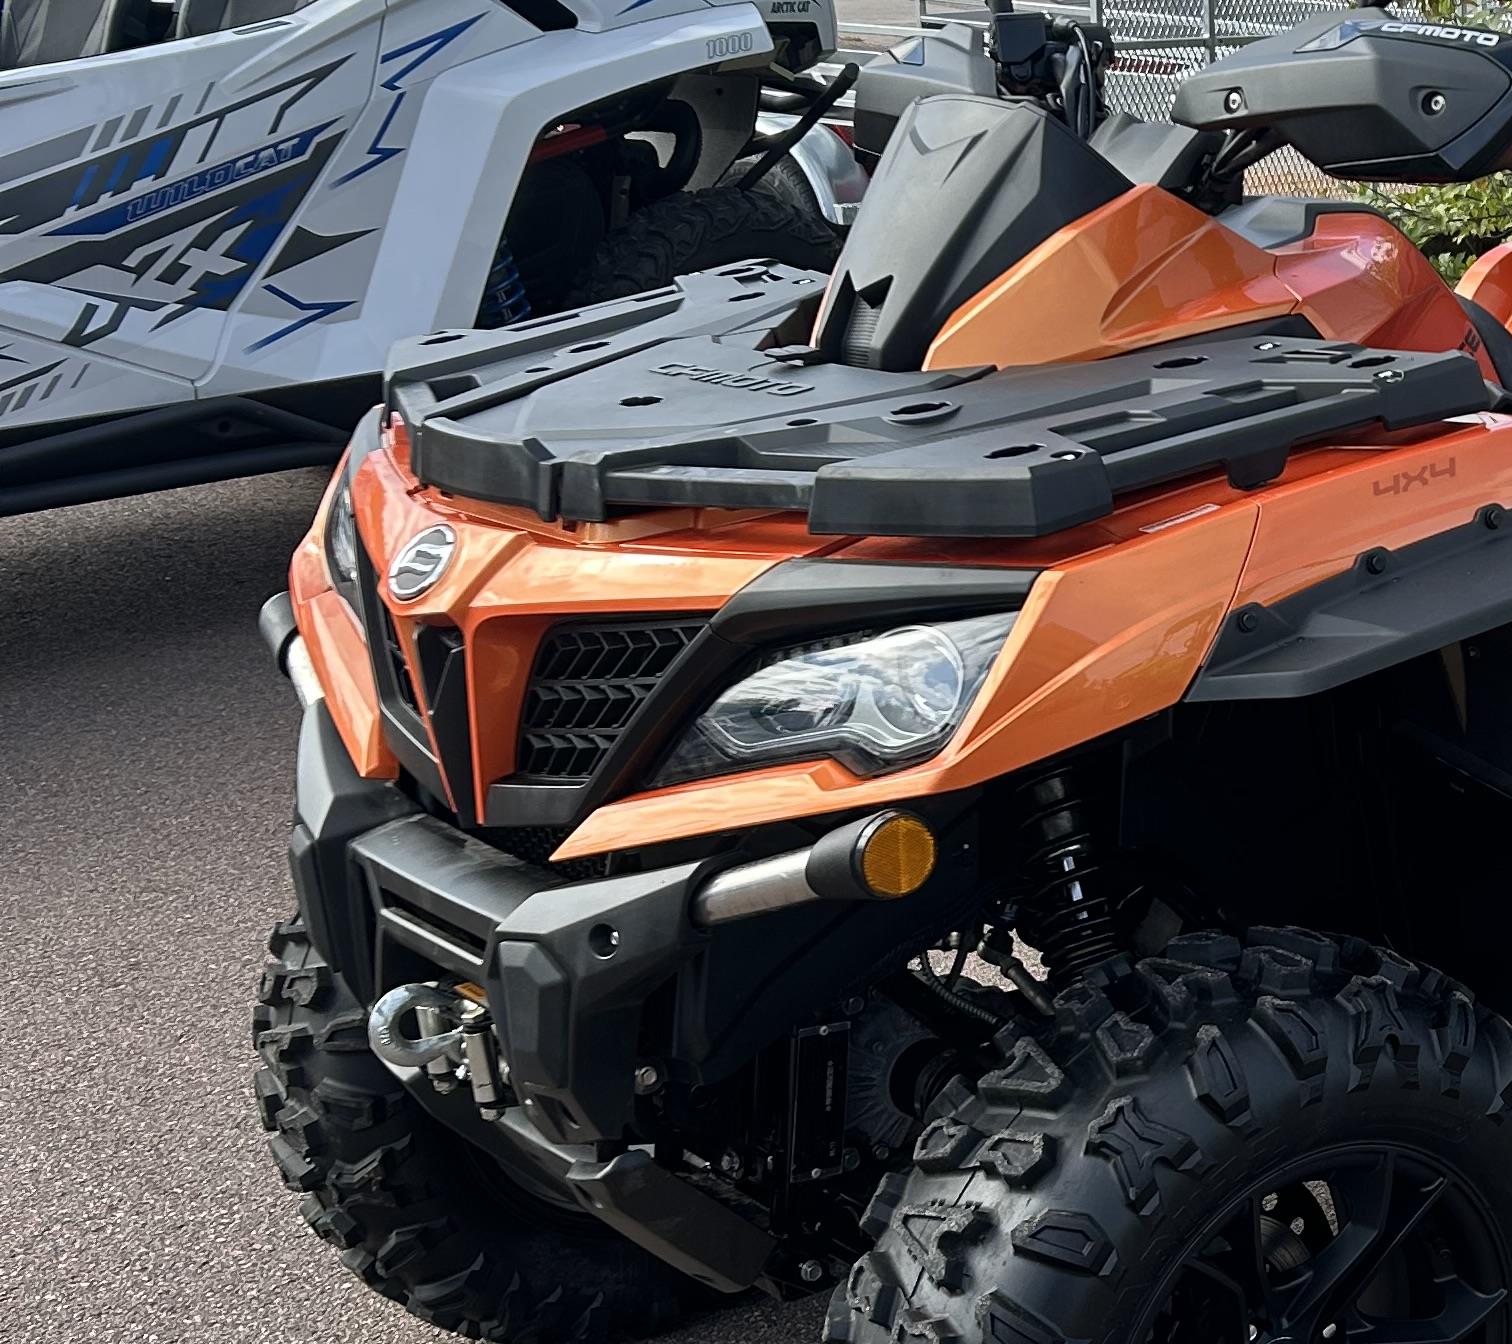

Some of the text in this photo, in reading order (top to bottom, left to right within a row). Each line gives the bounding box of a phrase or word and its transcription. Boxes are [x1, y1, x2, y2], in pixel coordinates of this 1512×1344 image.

[771, 0, 811, 14] ARCTIC CAT
[706, 32, 753, 59] 1000
[1380, 22, 1500, 46] CFMOTO
[127, 137, 301, 222] WILDCAT
[649, 361, 816, 397] CFMOTO
